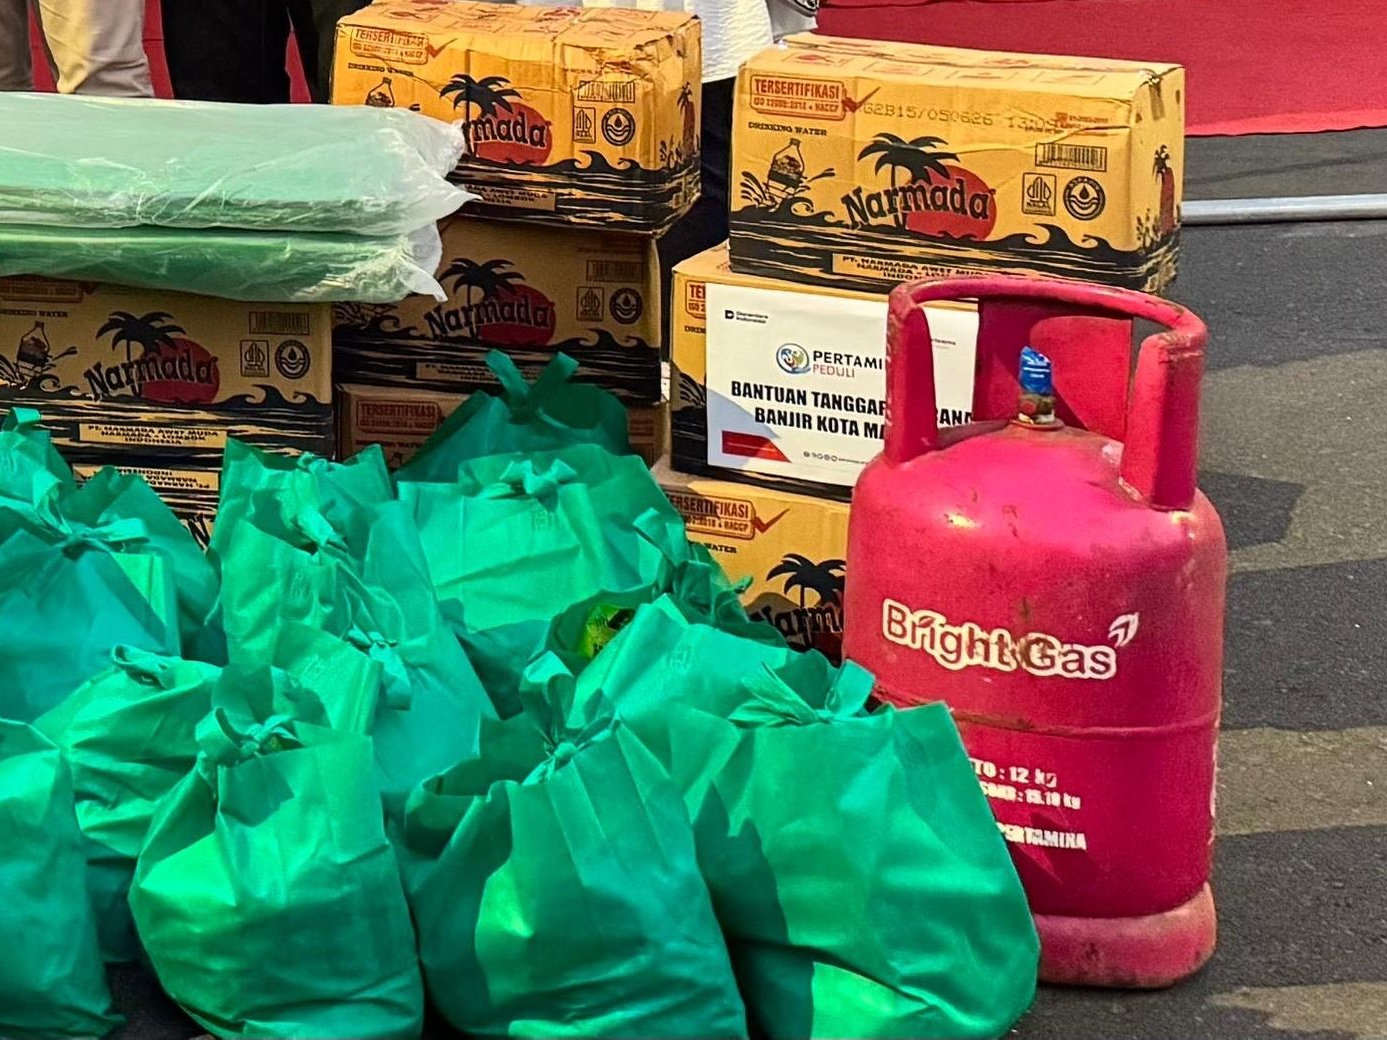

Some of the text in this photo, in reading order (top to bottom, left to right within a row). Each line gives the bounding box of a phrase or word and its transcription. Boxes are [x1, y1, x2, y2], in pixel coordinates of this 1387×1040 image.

[754, 79, 839, 99] TERSERTIFIKASI
[466, 112, 547, 150] rmada
[796, 125, 827, 136] WATER
[841, 176, 990, 230] Narmada
[425, 297, 550, 340] Narmada
[813, 350, 882, 370] PERTAMI
[813, 364, 855, 378] PEDULI
[84, 348, 215, 402] Narmada
[731, 381, 807, 405] BANTUAN
[755, 407, 812, 429] BANJIR
[816, 414, 859, 436] KOTA
[670, 495, 749, 519] ERSERTIFIKASI
[883, 598, 1018, 672] Bright
[1020, 632, 1117, 679] Gas
